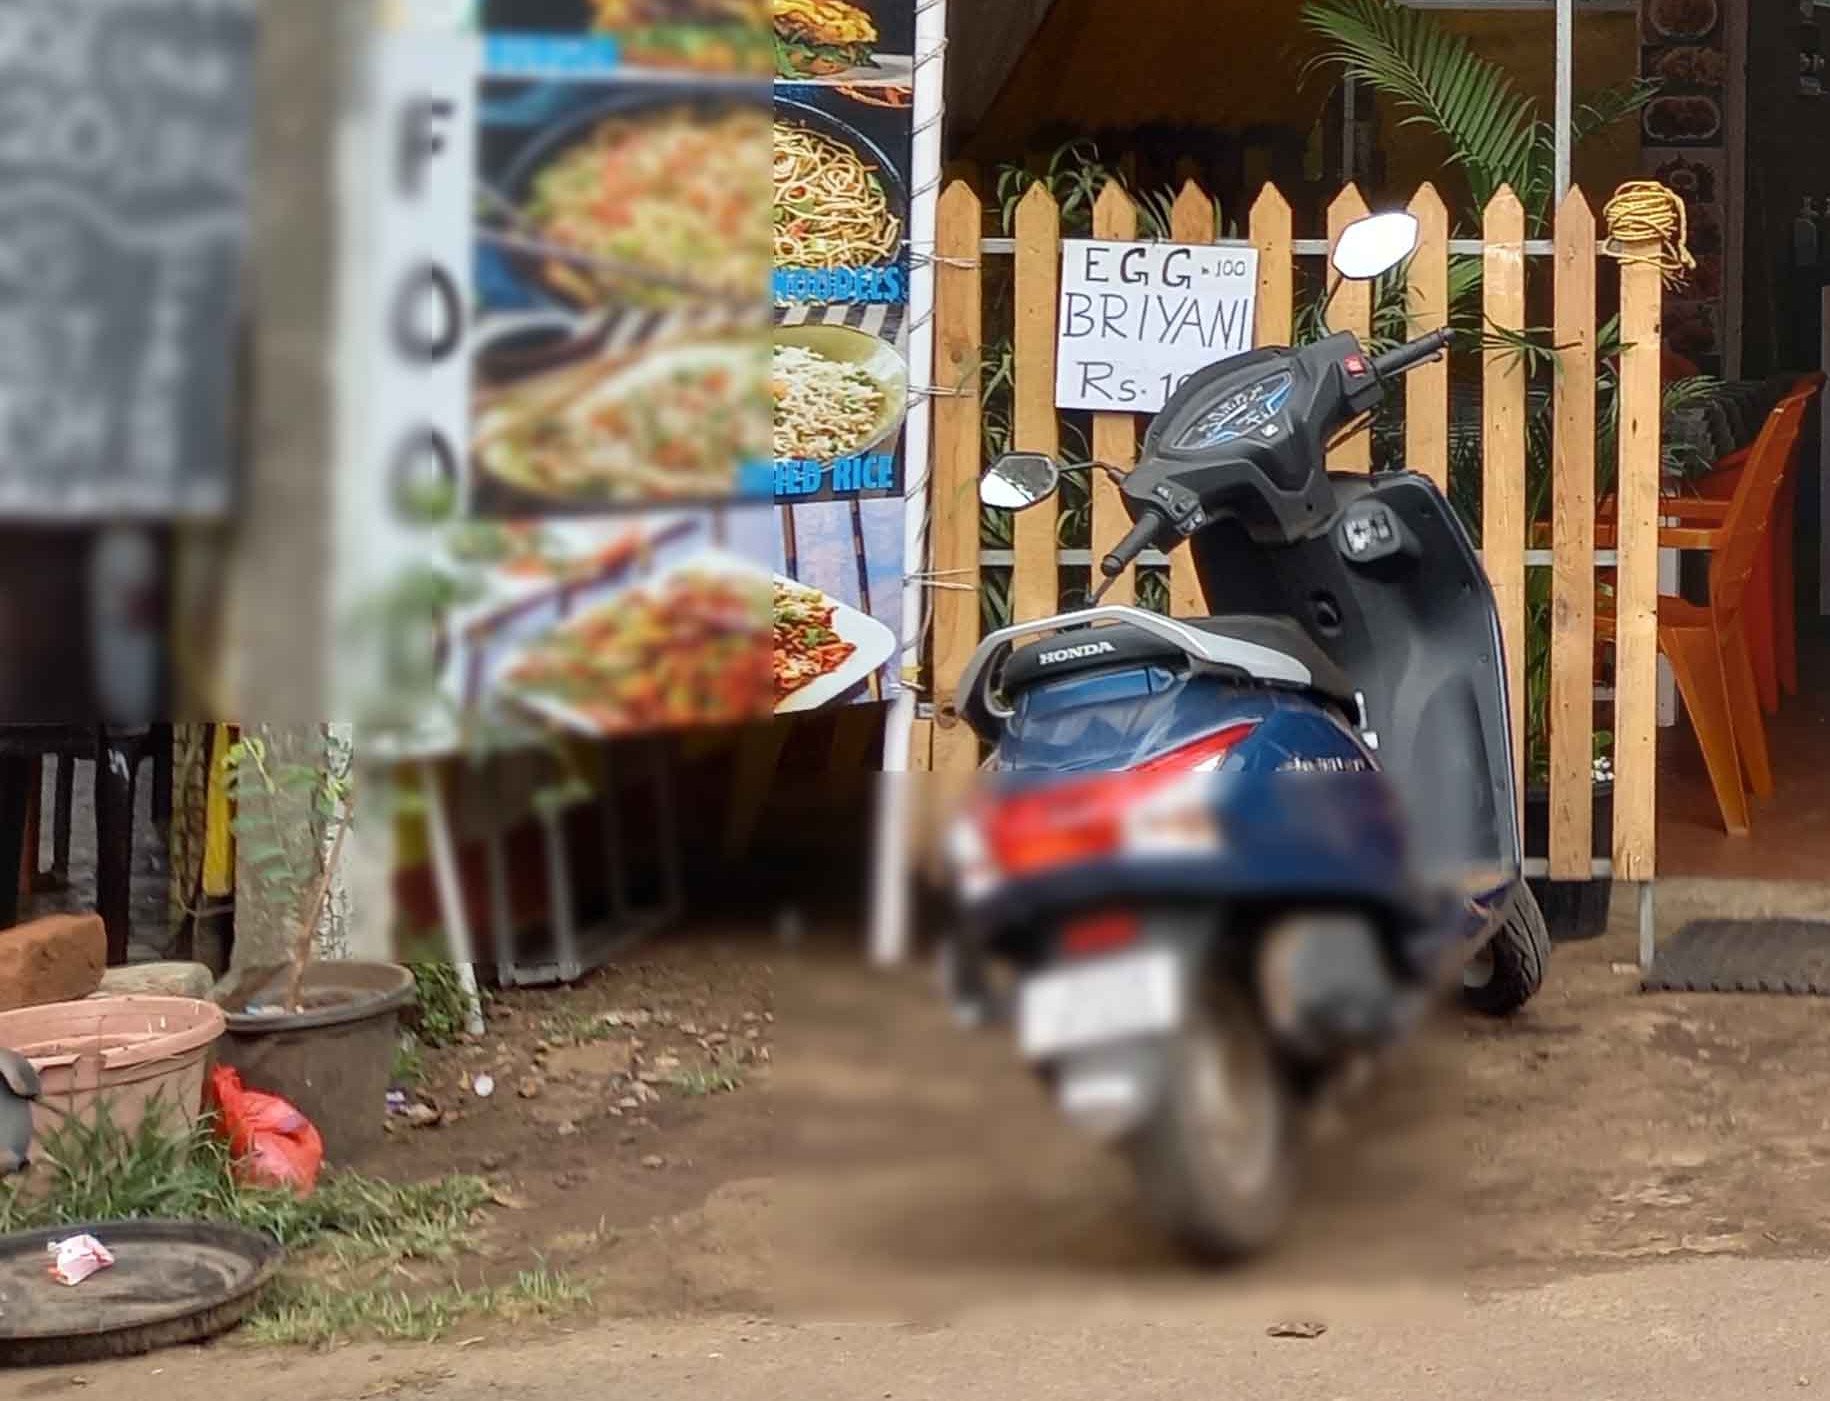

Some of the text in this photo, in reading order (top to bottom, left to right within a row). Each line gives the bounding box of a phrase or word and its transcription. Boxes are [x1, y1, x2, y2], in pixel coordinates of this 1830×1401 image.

[1084, 247, 1192, 289] EGG
[1062, 291, 1250, 351] BRIYANI
[832, 454, 894, 491] RICE
[1039, 641, 1117, 665] HONDA
